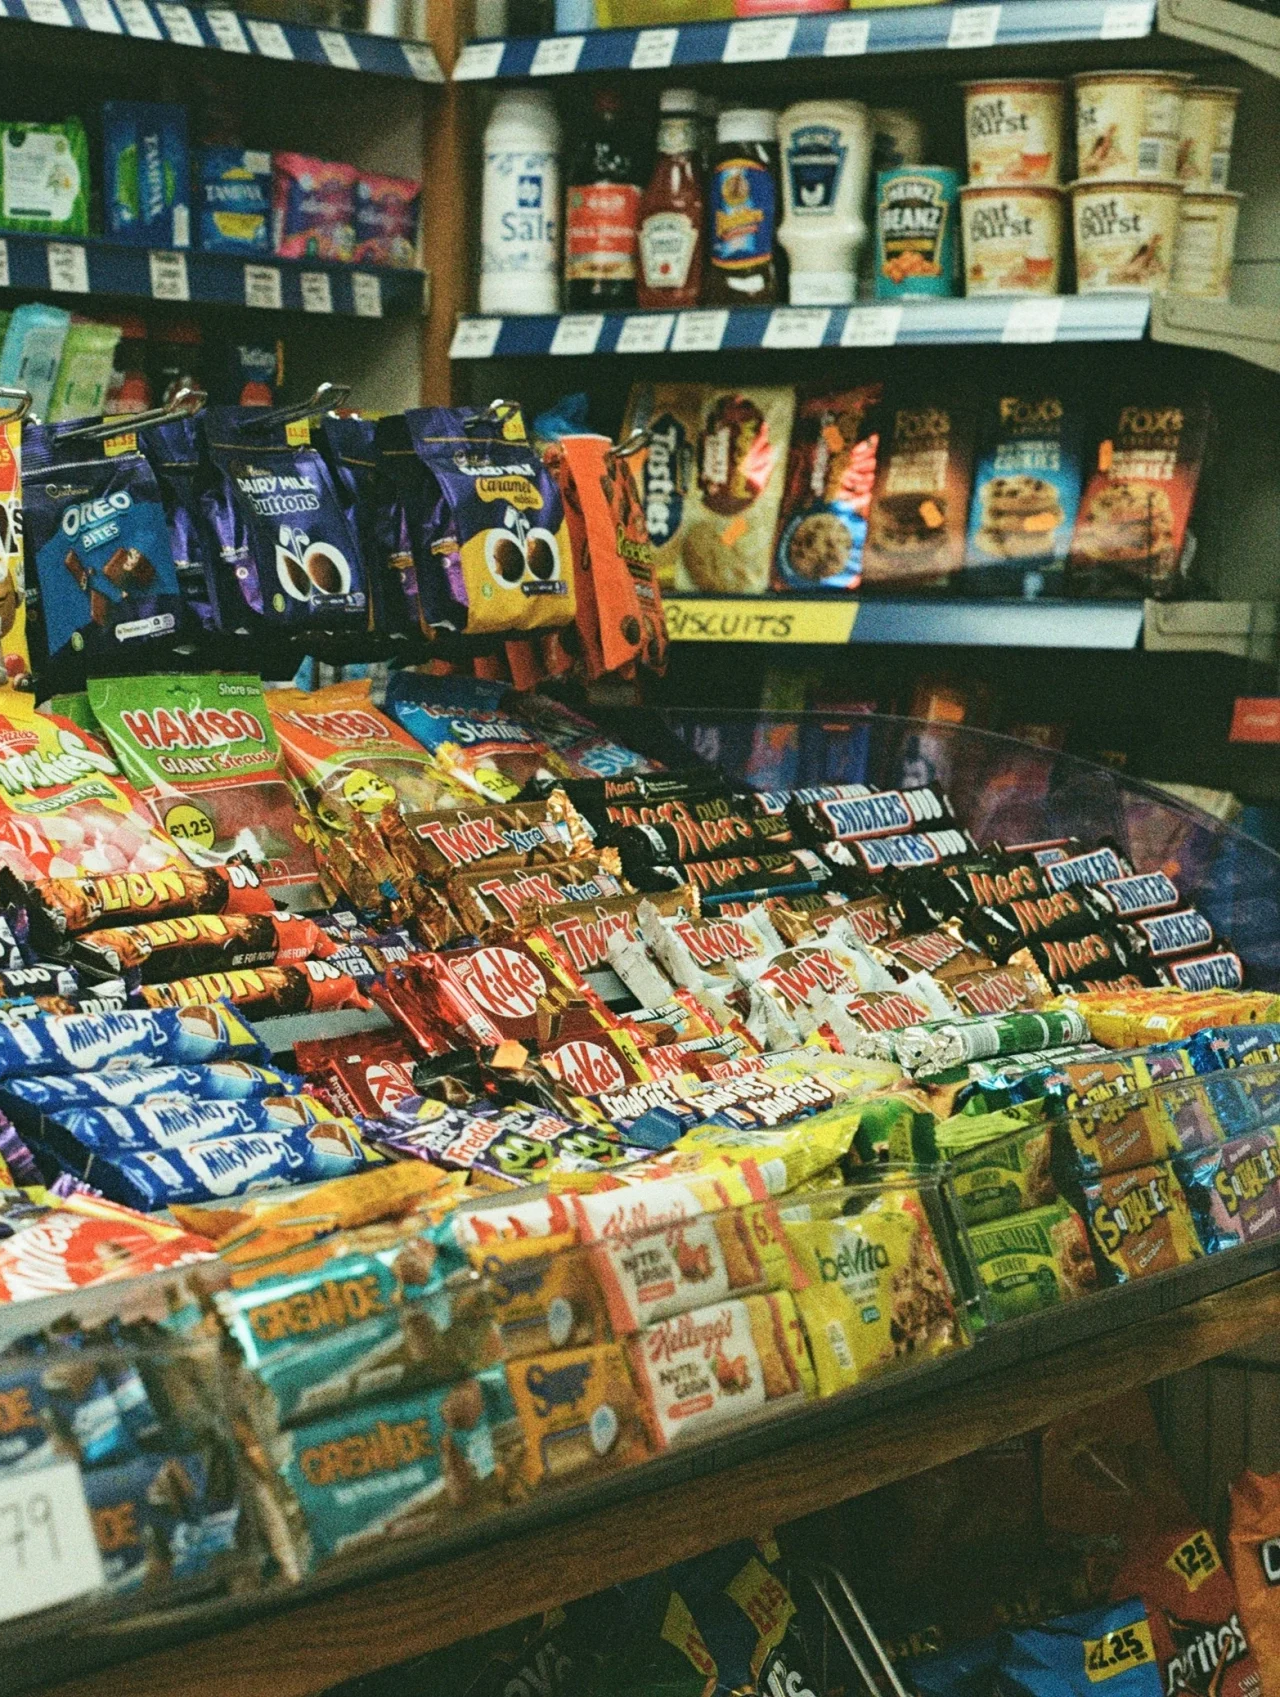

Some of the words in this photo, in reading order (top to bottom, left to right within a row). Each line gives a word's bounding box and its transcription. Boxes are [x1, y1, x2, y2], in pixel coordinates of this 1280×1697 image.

[501, 211, 556, 242] Salt
[236, 477, 277, 494] DAIRY
[281, 476, 318, 491] MILK
[478, 477, 532, 494] Caramel
[645, 426, 677, 536] Tasties
[62, 491, 131, 537] OREO
[81, 522, 120, 549] BITES
[219, 681, 245, 697] Share
[122, 707, 268, 751] HARIBO
[157, 754, 214, 776] GIANT
[604, 780, 637, 798] Mars
[170, 818, 213, 841] £1.25
[827, 794, 911, 834] SNICKERS
[417, 811, 508, 868] Twix
[505, 827, 545, 854] Xtra
[671, 816, 754, 861] Mars
[99, 867, 186, 911] LION
[684, 855, 761, 891] Mars
[968, 864, 1039, 906] Mars
[1049, 848, 1122, 891] SNICKERS
[480, 864, 565, 926] Twix
[561, 880, 601, 901] Xtra
[1107, 876, 1176, 910] SNICKERS
[140, 914, 230, 947] LION
[1010, 890, 1081, 936] Mars
[673, 913, 758, 966] Twix
[886, 926, 964, 971] Twix
[1147, 915, 1212, 952] SNICKERS
[759, 945, 849, 1007] Twix
[1041, 932, 1111, 981] Mars
[1177, 958, 1243, 992] SNICKERS
[6, 967, 53, 987] DUO
[172, 968, 266, 1006] LION
[468, 950, 547, 1018] KitKat
[954, 966, 1028, 1012] Twix
[847, 989, 930, 1031] Twix
[139, 1015, 168, 1047] 2
[228, 1107, 254, 1133] 2
[274, 1134, 306, 1168] 2
